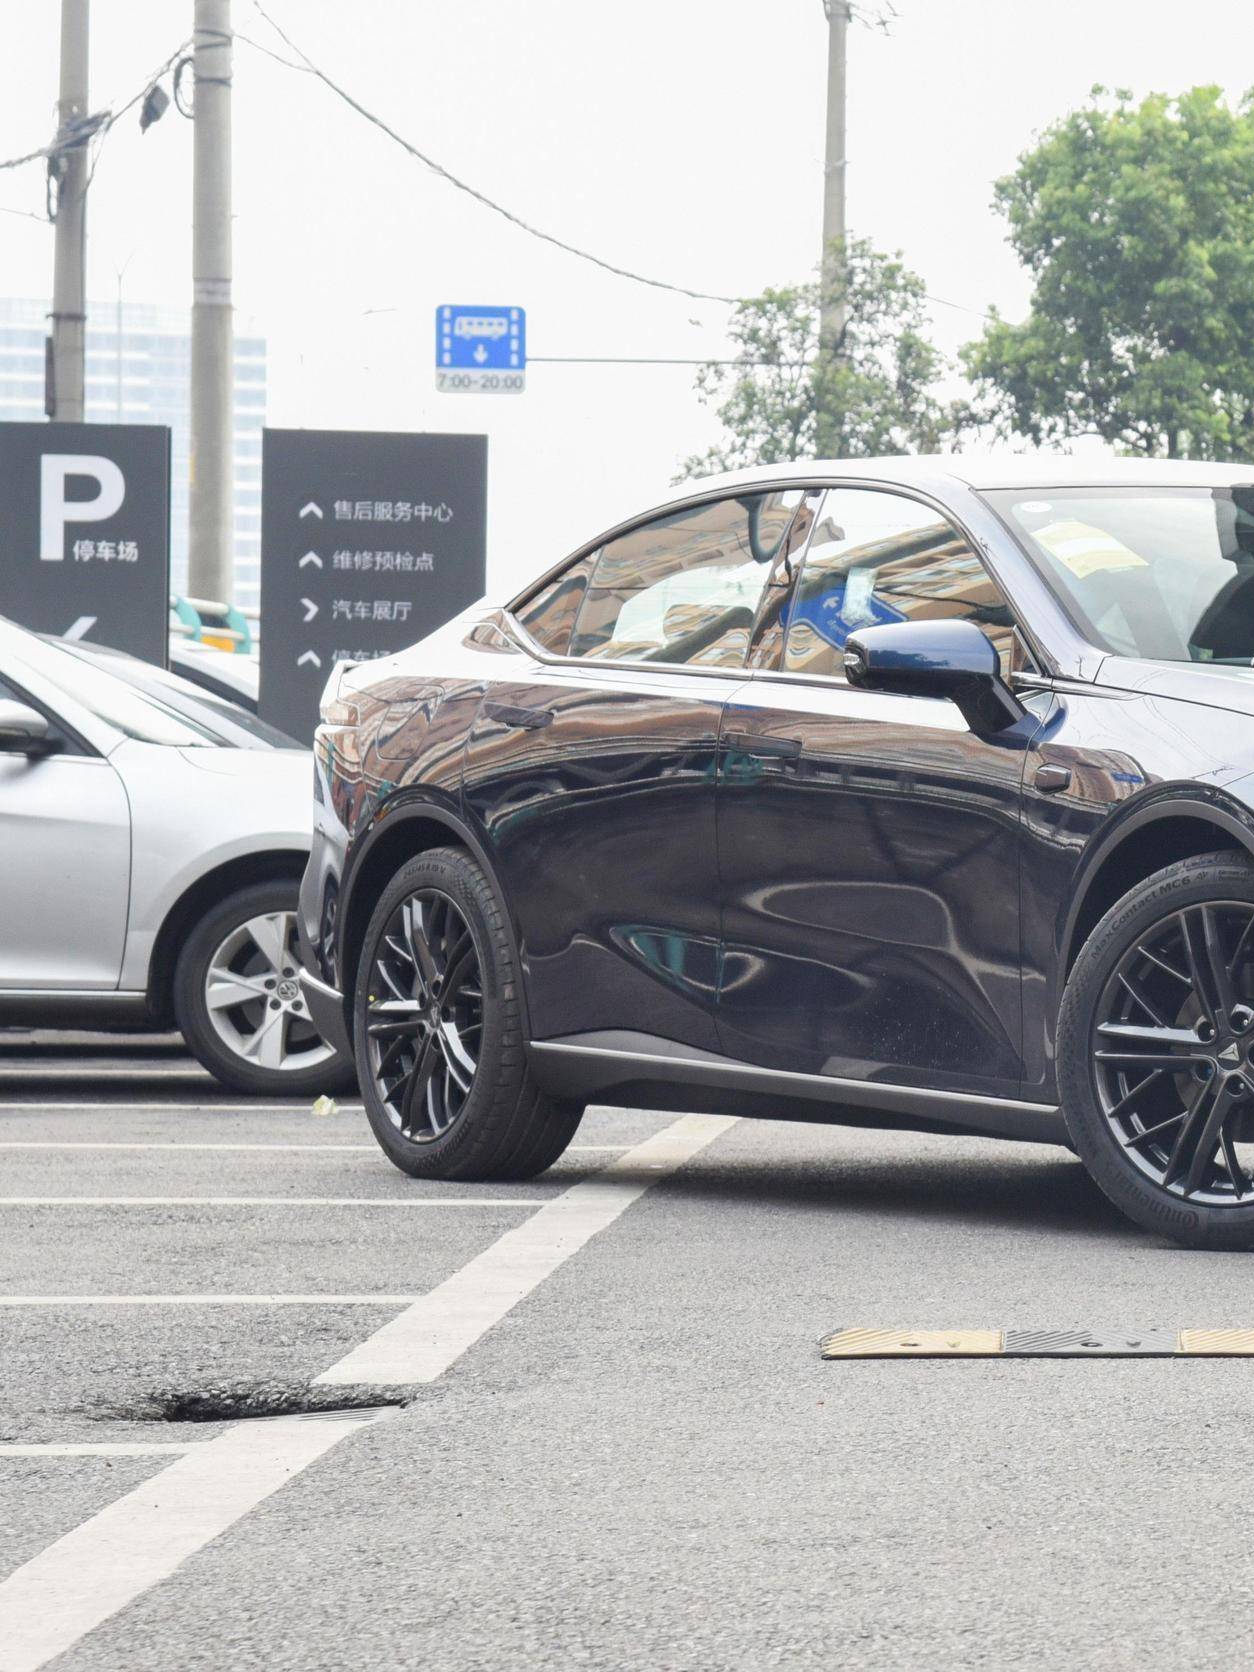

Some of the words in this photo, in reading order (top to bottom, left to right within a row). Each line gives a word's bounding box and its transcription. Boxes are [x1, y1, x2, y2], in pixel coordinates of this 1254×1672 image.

[438, 373, 523, 389] 7:00-20:00
[41, 454, 126, 561] P
[333, 500, 453, 522] 售后服务中心
[73, 540, 138, 562] 停车场
[332, 550, 434, 571] 维修预检点
[332, 600, 412, 621] 汽车展厅
[1159, 875, 1192, 895] MC6
